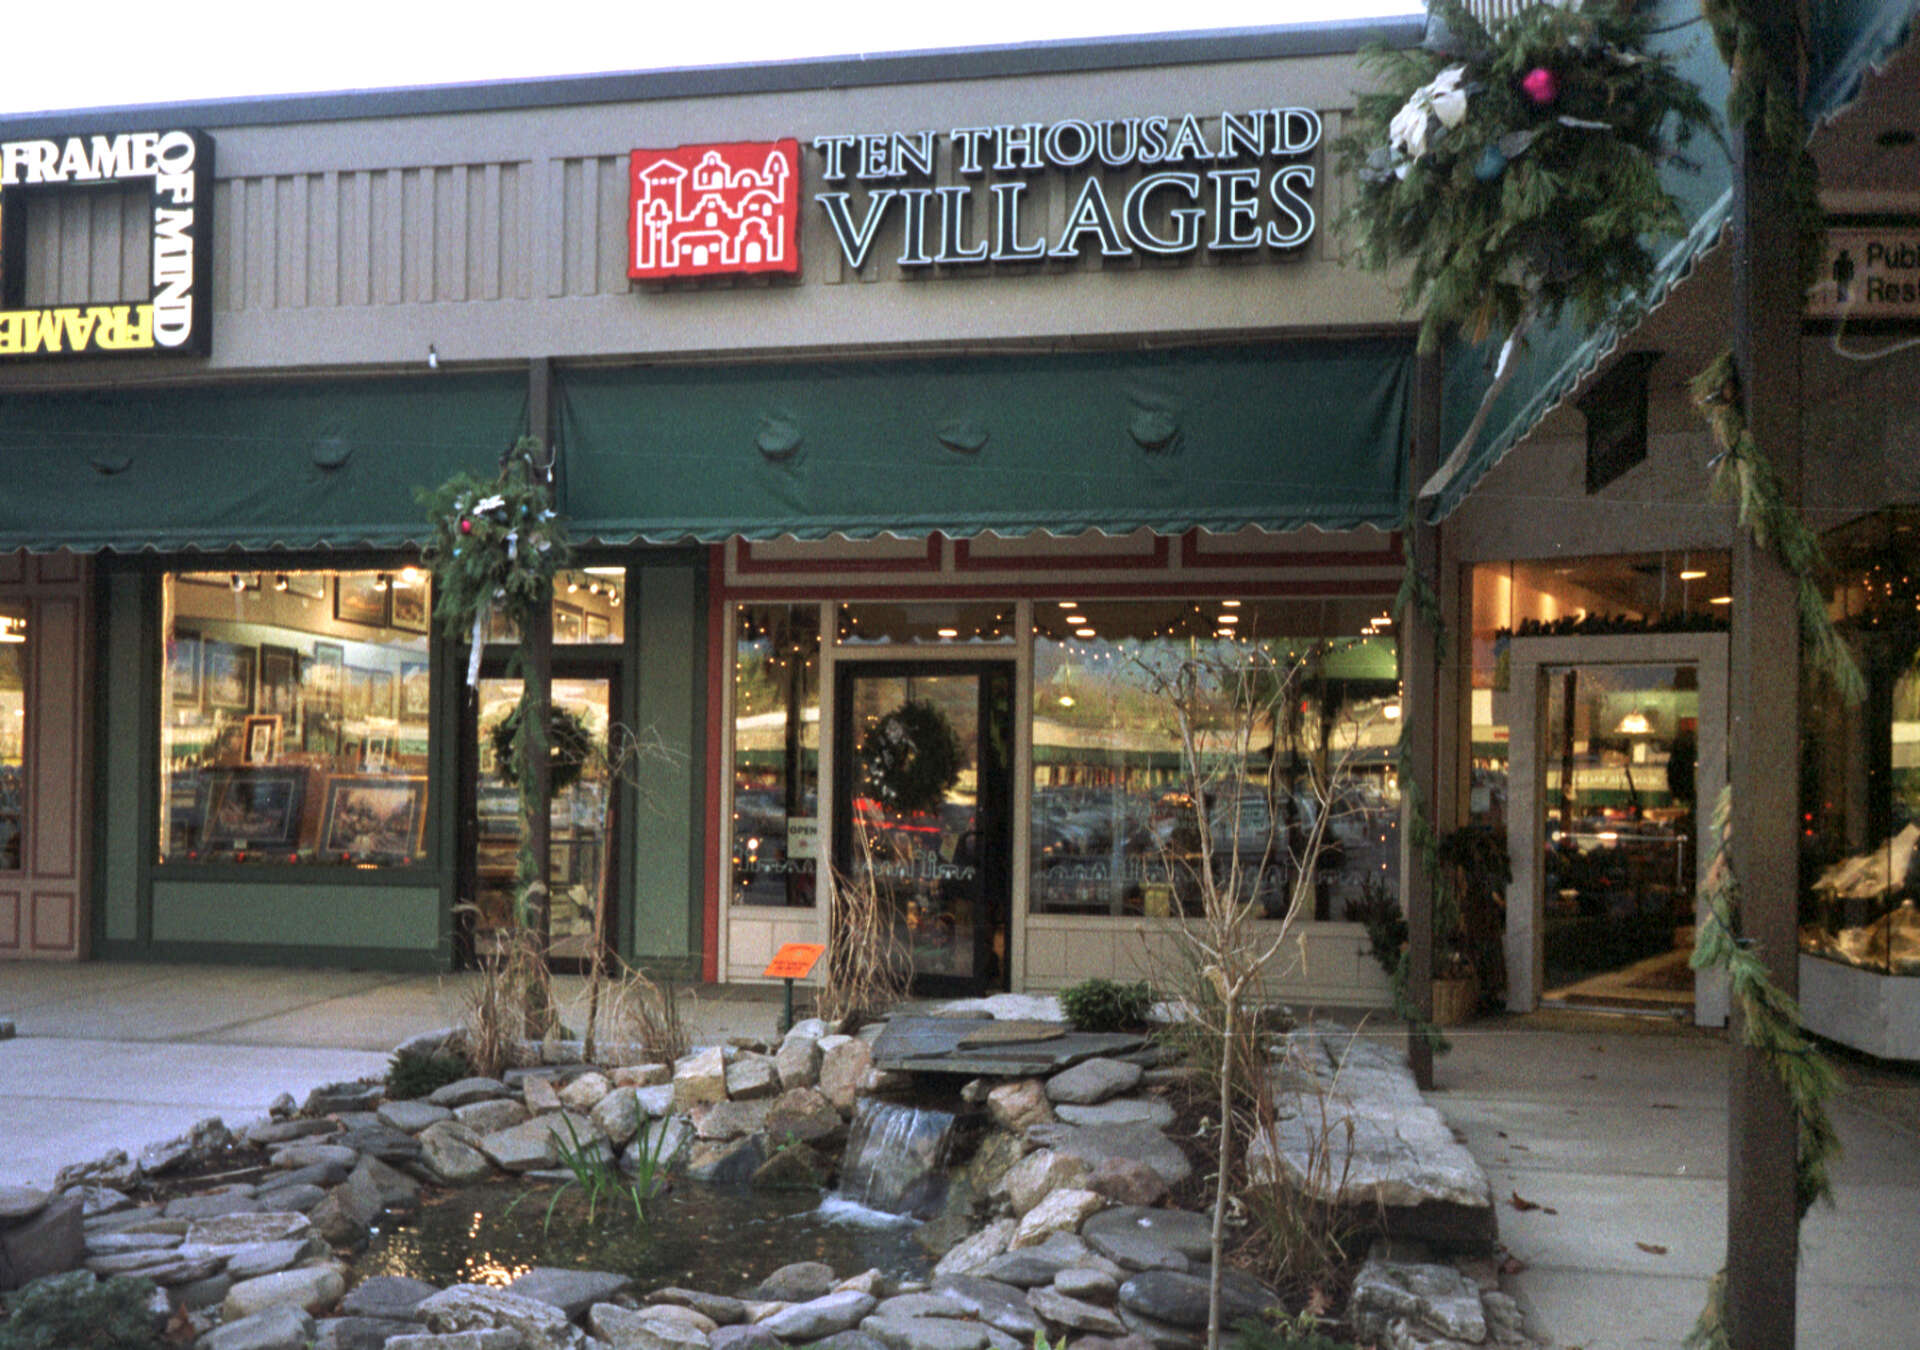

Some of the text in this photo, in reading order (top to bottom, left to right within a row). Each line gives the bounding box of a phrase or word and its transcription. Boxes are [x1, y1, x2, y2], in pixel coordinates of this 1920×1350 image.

[1, 132, 159, 185] FRAME
[813, 107, 1322, 180] TEN THOUSAND
[153, 131, 195, 347] OF MIND
[814, 165, 1316, 268] VILLAGES
[1867, 276, 1920, 304] Res
[0, 304, 155, 354] FRAME
[790, 825, 818, 835] OPEN
